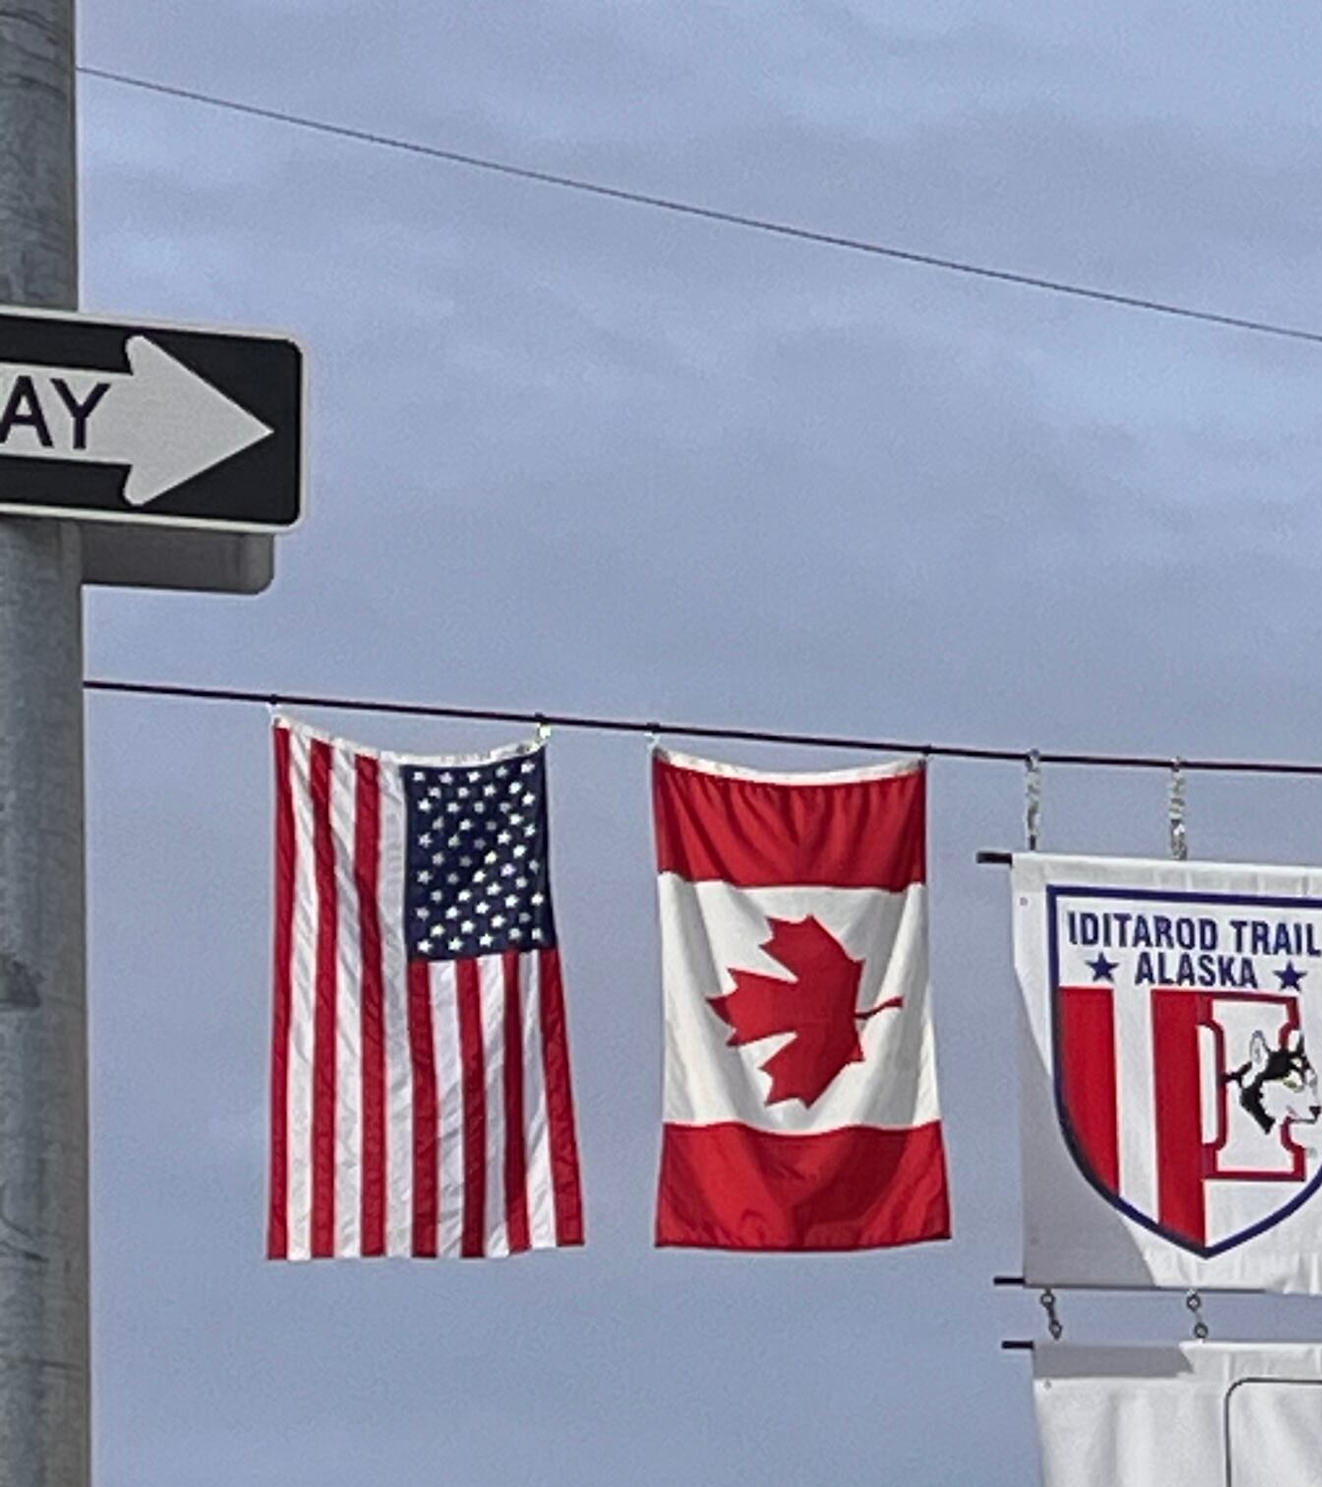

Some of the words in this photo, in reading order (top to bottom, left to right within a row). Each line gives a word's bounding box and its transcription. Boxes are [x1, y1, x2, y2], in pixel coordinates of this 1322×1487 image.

[1068, 912, 1218, 951] IDITAROD
[1229, 919, 1322, 957] TRAIL
[1135, 952, 1258, 989] ALASKA
